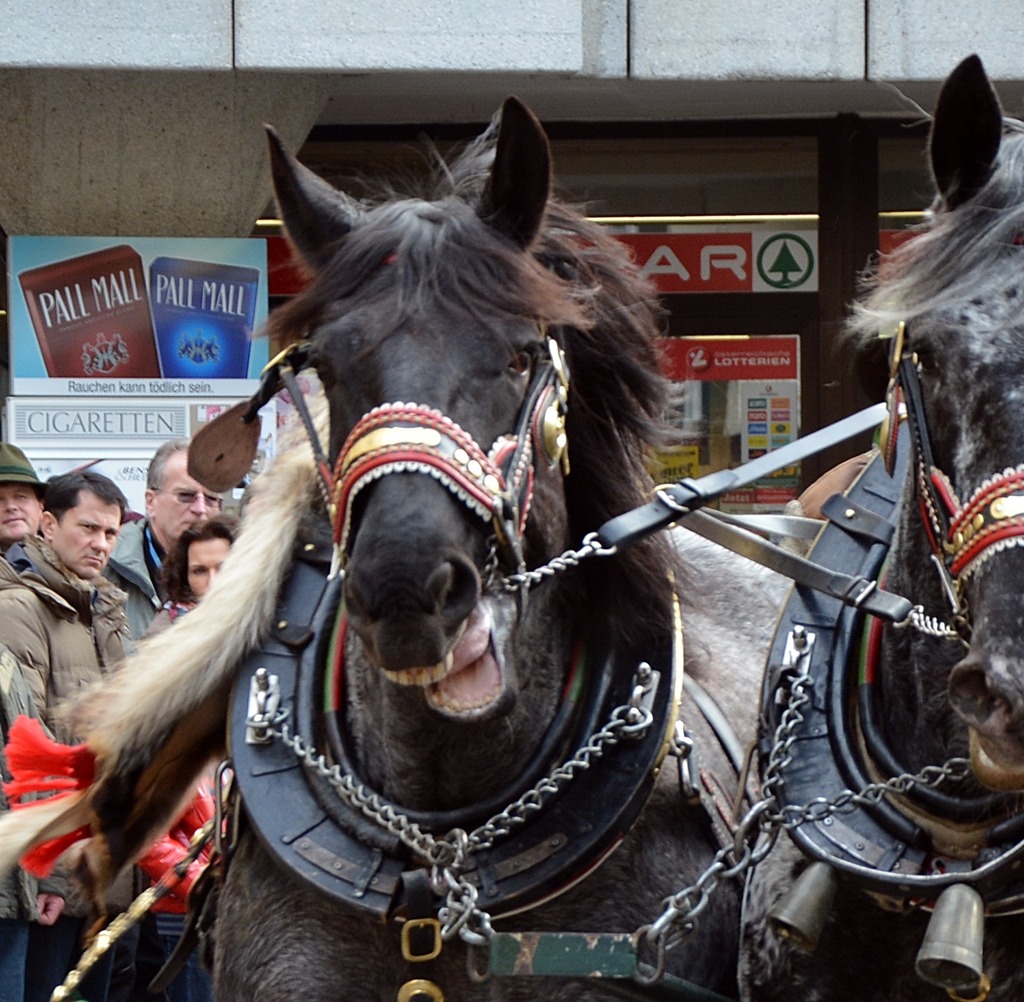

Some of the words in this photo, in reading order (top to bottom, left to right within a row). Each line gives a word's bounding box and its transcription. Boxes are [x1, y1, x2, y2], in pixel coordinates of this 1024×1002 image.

[39, 283, 91, 328] PALL
[91, 267, 143, 312] MALL
[156, 274, 197, 309] PALL
[201, 280, 246, 316] MALL
[714, 357, 791, 366] LOTTERIEN
[68, 380, 116, 393] Rauchen
[119, 381, 146, 393] kann
[149, 380, 186, 393] tödlich
[188, 381, 214, 393] sein.
[27, 412, 174, 433] CIGARETTEN
